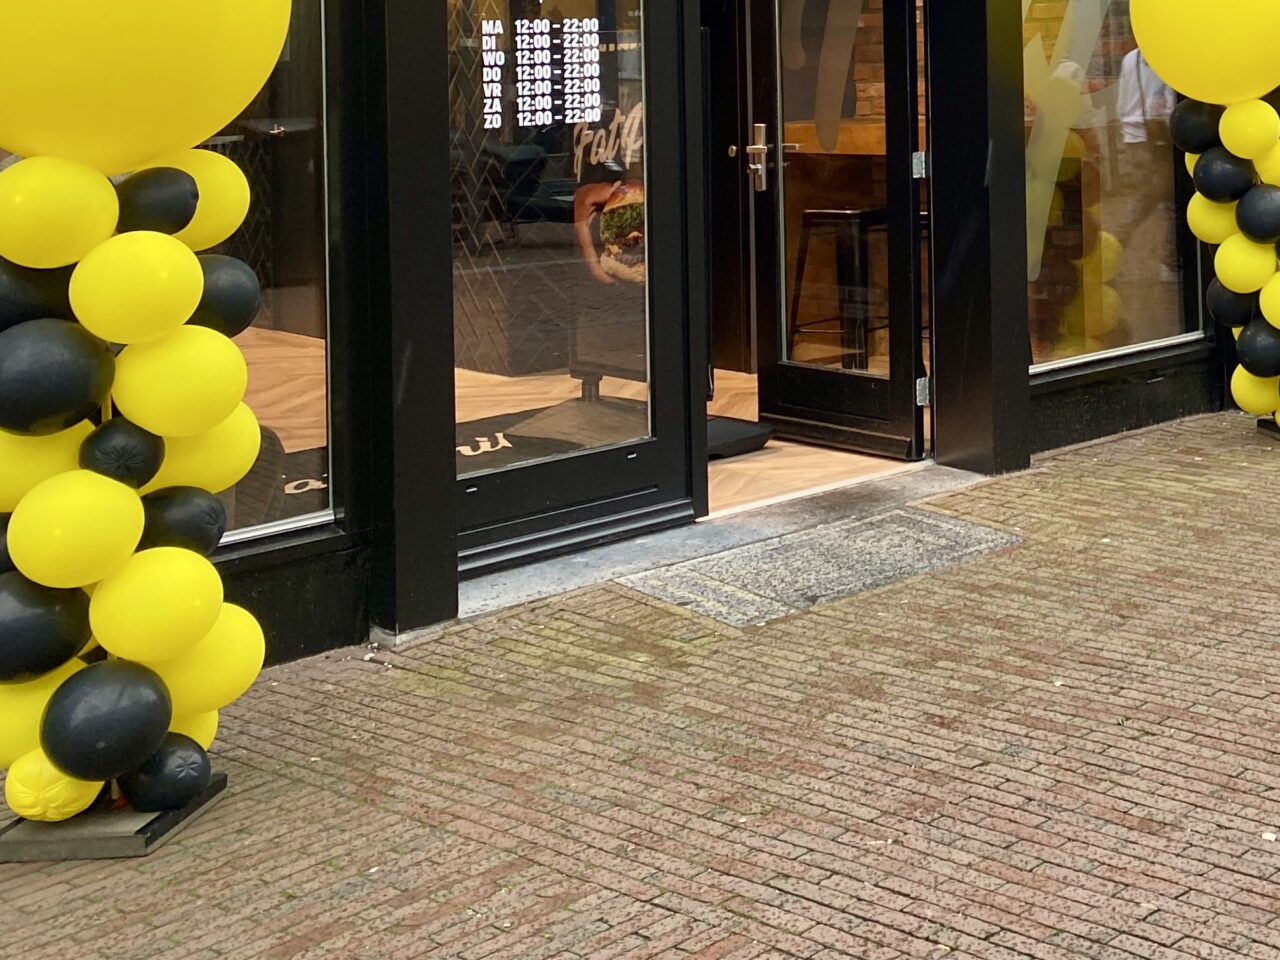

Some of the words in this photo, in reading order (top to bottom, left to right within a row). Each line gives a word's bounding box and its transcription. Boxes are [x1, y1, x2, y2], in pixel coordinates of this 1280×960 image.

[482, 20, 503, 34] MA
[515, 19, 550, 34] 12:00
[563, 18, 599, 33] 22:00
[482, 36, 496, 50] DI
[515, 34, 550, 50] 12:00
[563, 33, 599, 48] 22:00
[482, 51, 505, 66] WO
[516, 50, 551, 64] 12:00
[563, 48, 599, 63] 22:00
[483, 67, 501, 82] DO
[516, 65, 551, 80] 12:00
[564, 63, 600, 78] 22:00
[483, 83, 502, 97] VR
[516, 80, 551, 95] 12:00
[564, 78, 600, 93] 22:00
[483, 98, 502, 113] ZA
[517, 96, 552, 110] 12:00
[564, 93, 600, 108] 22:00
[484, 114, 502, 129] ZO
[517, 111, 552, 126] 12:00
[565, 108, 601, 123] 22:00
